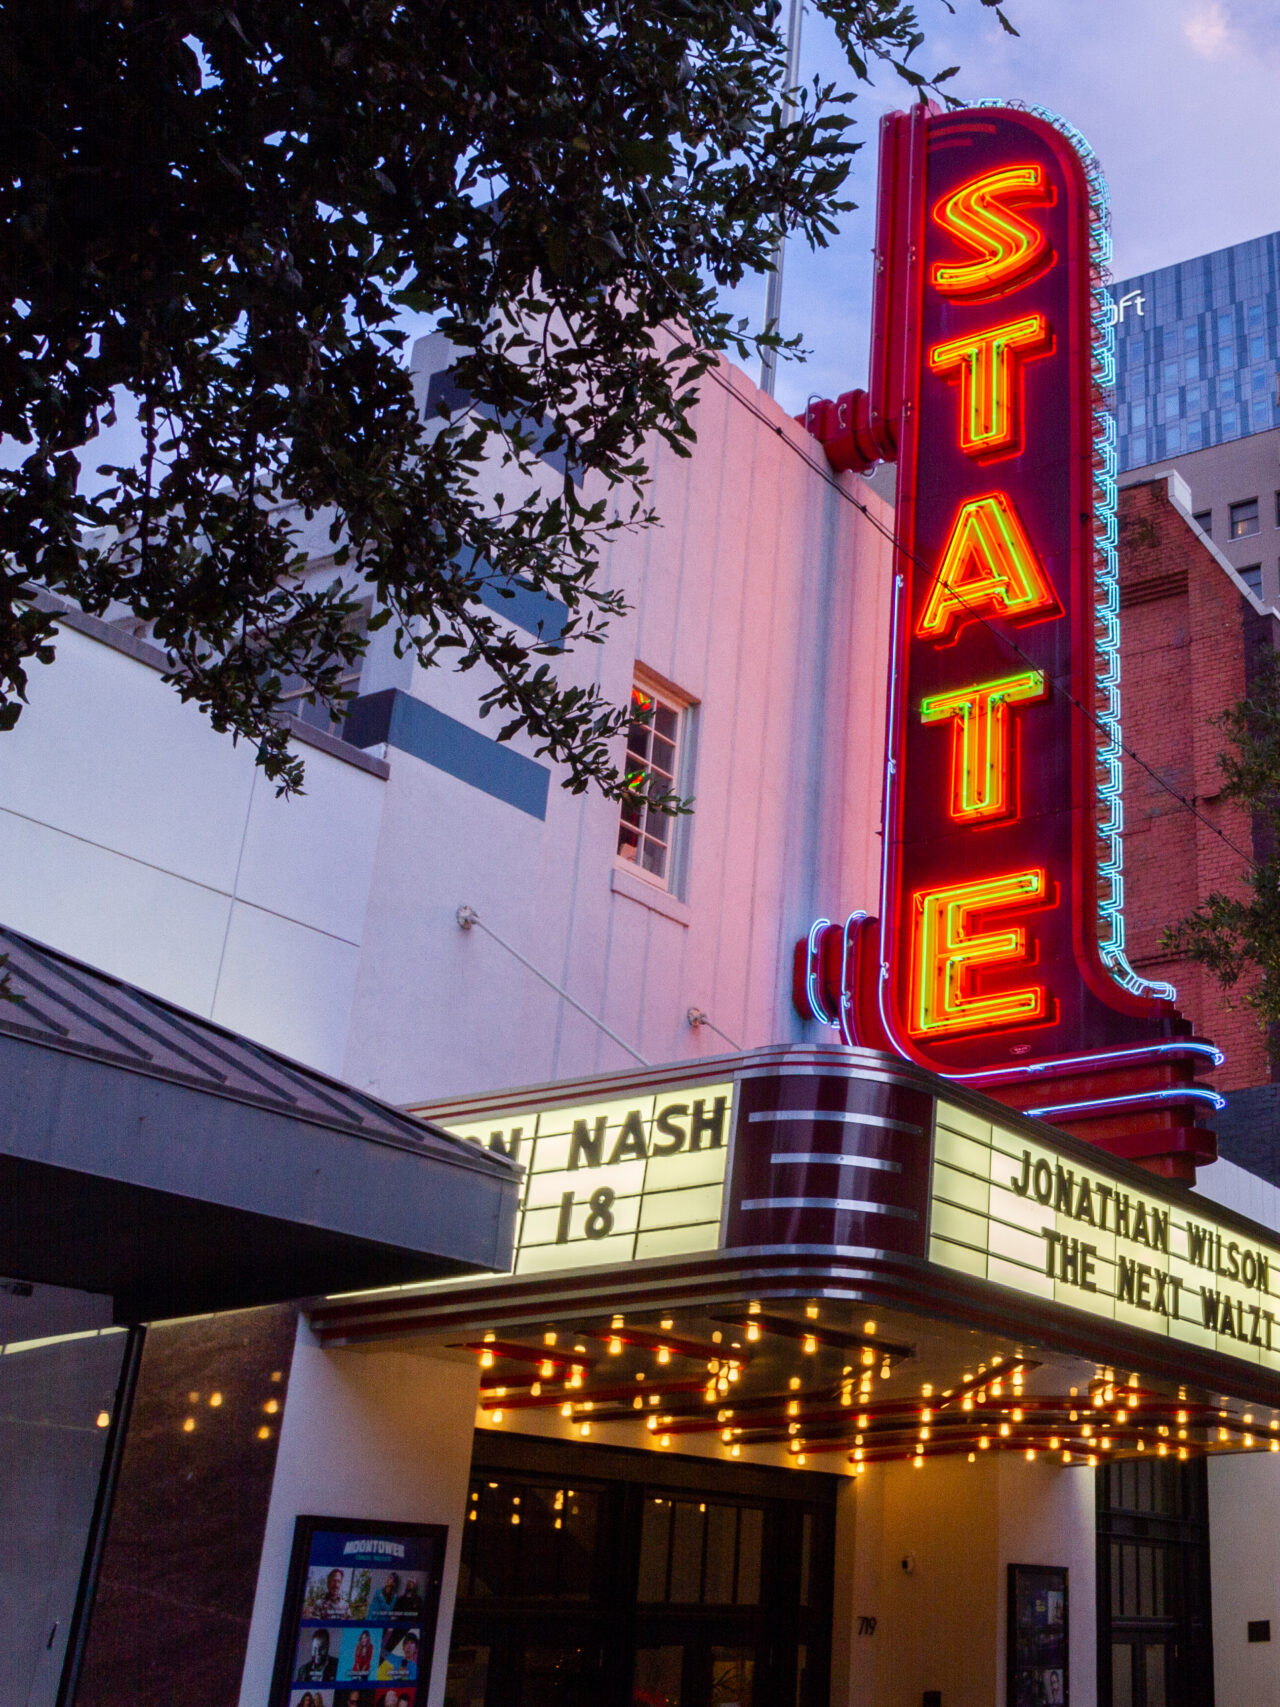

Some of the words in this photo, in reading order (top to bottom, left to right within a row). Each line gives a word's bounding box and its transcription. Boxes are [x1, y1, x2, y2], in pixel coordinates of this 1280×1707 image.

[907, 164, 1063, 1043] STATE
[566, 1096, 728, 1171] NASH
[556, 1186, 616, 1245] 18
[1011, 1149, 1169, 1254] JONATHAN
[1186, 1220, 1270, 1295] WILSON
[1041, 1226, 1099, 1293] THE
[1117, 1254, 1184, 1320] NEXT
[1200, 1285, 1275, 1351] WALZT
[857, 1616, 878, 1636] 719
